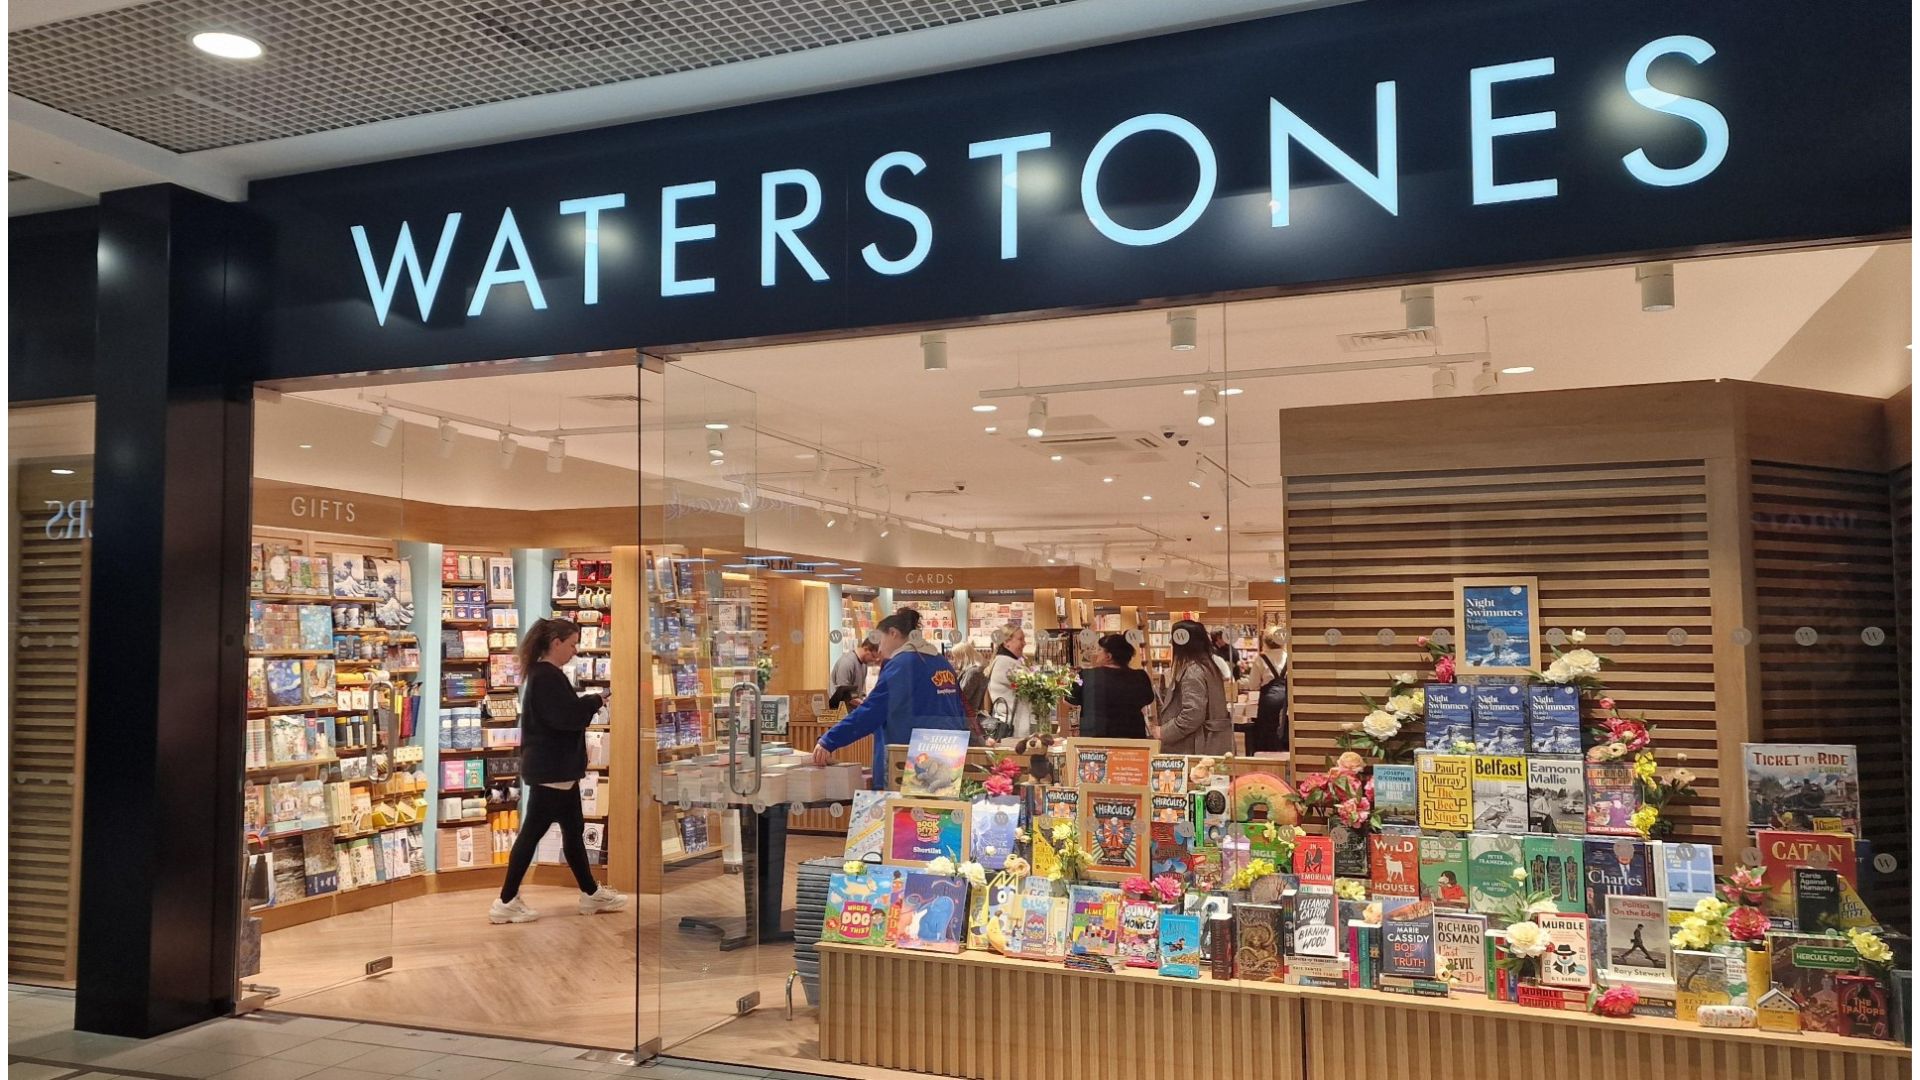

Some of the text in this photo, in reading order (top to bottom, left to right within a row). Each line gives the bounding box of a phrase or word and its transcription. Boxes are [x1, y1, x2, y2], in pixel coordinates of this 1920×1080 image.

[350, 33, 1730, 327] WATERSTONES
[291, 496, 356, 523] GIFTS
[905, 573, 954, 585] CARDS
[1466, 598, 1495, 608] Night
[1466, 608, 1523, 617] Swimmers
[1428, 694, 1448, 704] Night
[1478, 695, 1498, 704] Night
[1533, 696, 1553, 704] Night
[1428, 702, 1468, 710] Swimmers
[1478, 703, 1519, 711] Swimmers
[1533, 703, 1575, 711] Swimmers
[1080, 752, 1105, 761] HERCULES
[1753, 752, 1800, 766] TICKET
[1817, 752, 1849, 766] RIDE
[1435, 763, 1454, 774] Paul
[1475, 758, 1523, 776] Belfast
[1530, 762, 1580, 775] Eamonn
[1430, 775, 1461, 787] Murray
[1530, 774, 1567, 785] Mallie
[1046, 791, 1077, 801] HERCULES
[1437, 787, 1453, 798] The
[1096, 803, 1134, 817] HERCULES
[1437, 799, 1454, 810] Bee
[1433, 811, 1458, 824] Sting
[916, 820, 940, 829] BOOK
[912, 846, 941, 855] Shortlist
[1374, 839, 1414, 853] WILD
[1300, 873, 1332, 881] EMORIAM
[1588, 869, 1643, 887] Charles
[1800, 872, 1821, 880] Cards
[1375, 882, 1415, 893] HOUSES
[1800, 878, 1827, 887] Against
[1800, 885, 1834, 894] Humanity
[1299, 899, 1331, 912] ELEANOR
[1622, 901, 1650, 909] Politics
[841, 911, 871, 927] DOG
[1300, 908, 1328, 921] CATTON
[1611, 907, 1626, 916] On
[1641, 909, 1661, 919] Edge
[1124, 918, 1156, 930] MONKEY
[1396, 926, 1420, 934] MARIE
[1541, 919, 1585, 931] MURDLE
[1298, 927, 1330, 941] BIRNAM
[1387, 933, 1430, 943] CASSIDY
[1438, 932, 1480, 945] OSMAN
[1302, 936, 1327, 950] WOOD
[1394, 943, 1423, 952] BODY
[1393, 956, 1426, 968] TRUTH
[1796, 952, 1856, 964] HERCULE POIROT
[1613, 966, 1666, 978] Rory Stewart
[1520, 986, 1560, 998] MURDLE
[1521, 997, 1561, 1009] MURDLE
[1841, 1003, 1886, 1017] TRAITORS
